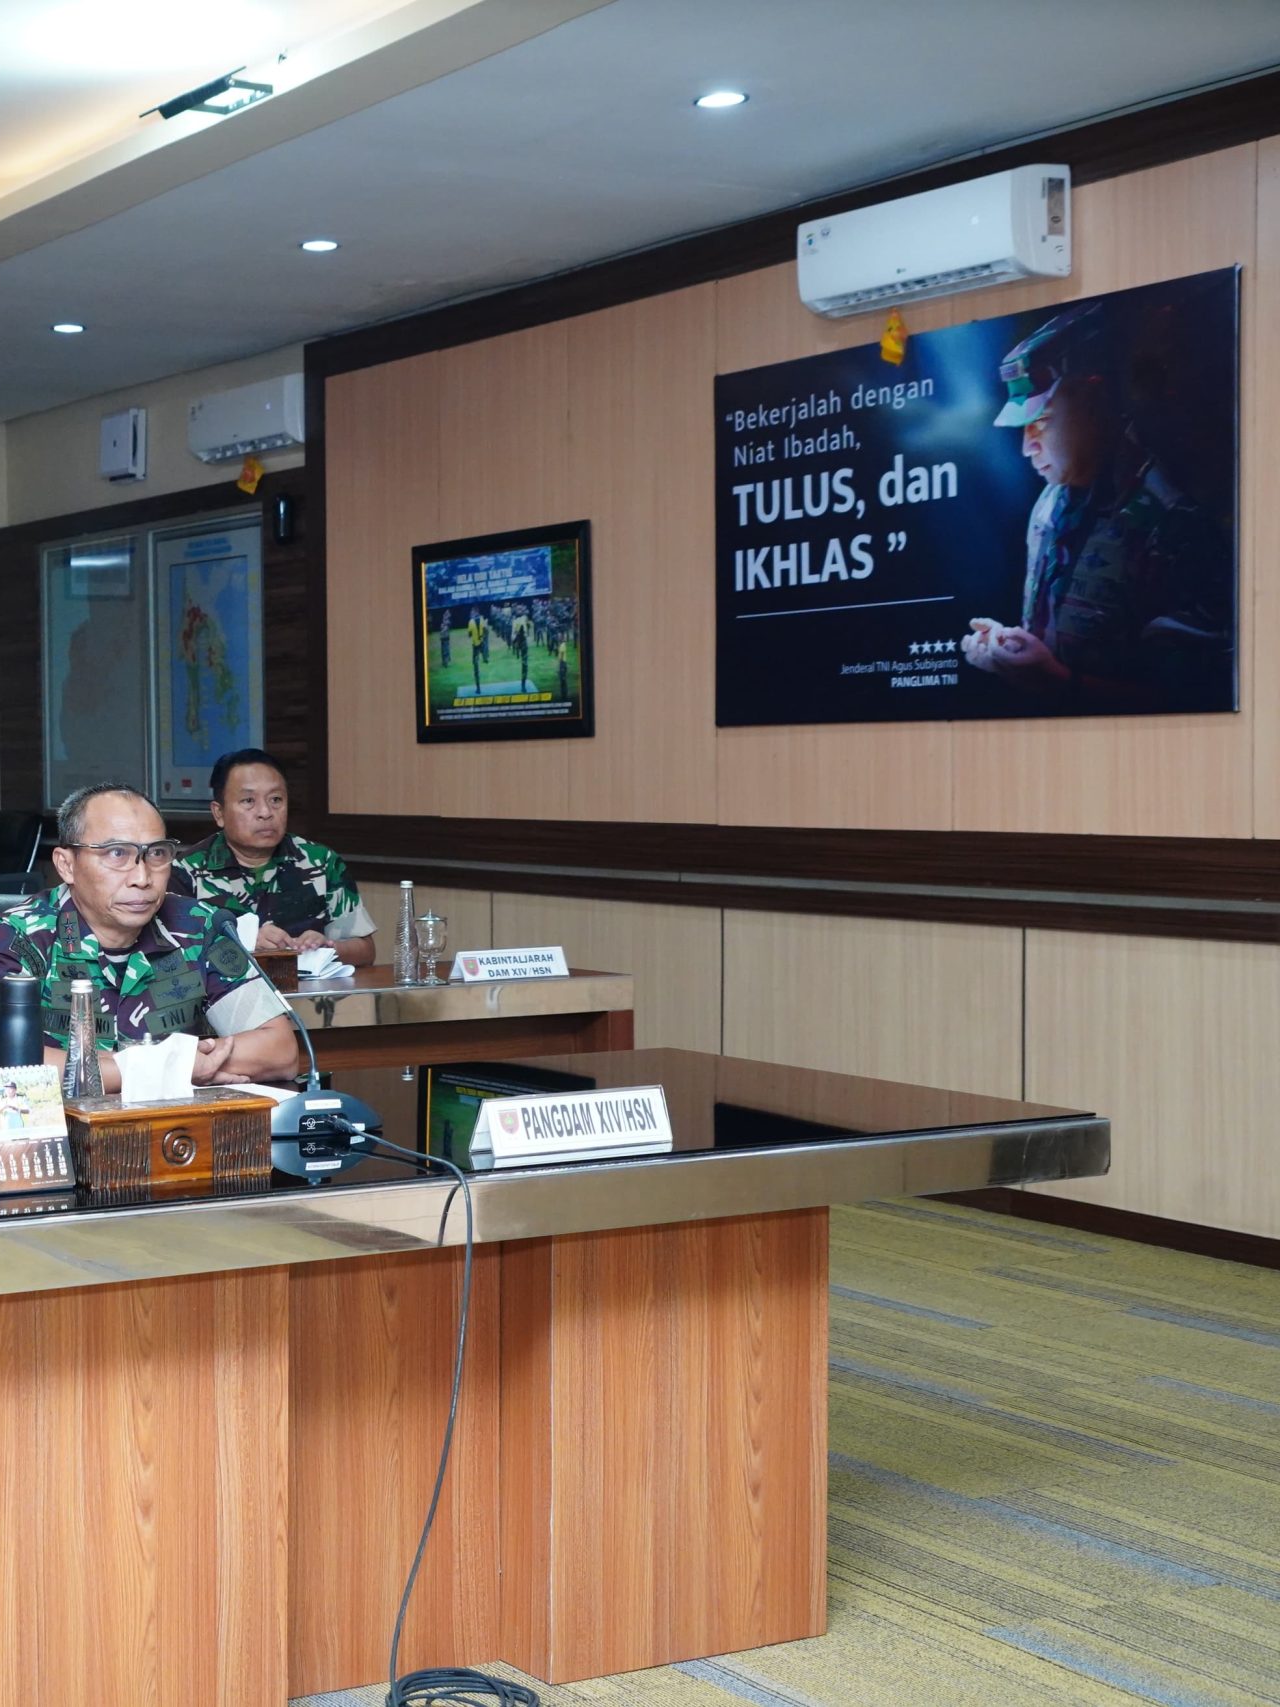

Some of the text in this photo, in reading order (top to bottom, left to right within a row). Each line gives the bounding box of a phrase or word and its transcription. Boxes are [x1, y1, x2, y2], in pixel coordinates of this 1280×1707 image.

[851, 378, 934, 410] dengan
[734, 424, 861, 467] Niat Ibadah,
[732, 454, 958, 526] TULUS, dan
[735, 533, 874, 592] IKHLAS
[840, 658, 958, 675] Jenderal TNI Agus Subiyanto
[890, 674, 958, 688] PANGLIMA TNI
[478, 953, 554, 966] KABINTALJARAH
[488, 968, 510, 978] DAM
[159, 1007, 186, 1029] TNI
[521, 1097, 657, 1140] PANGDAM XIV/HSN
